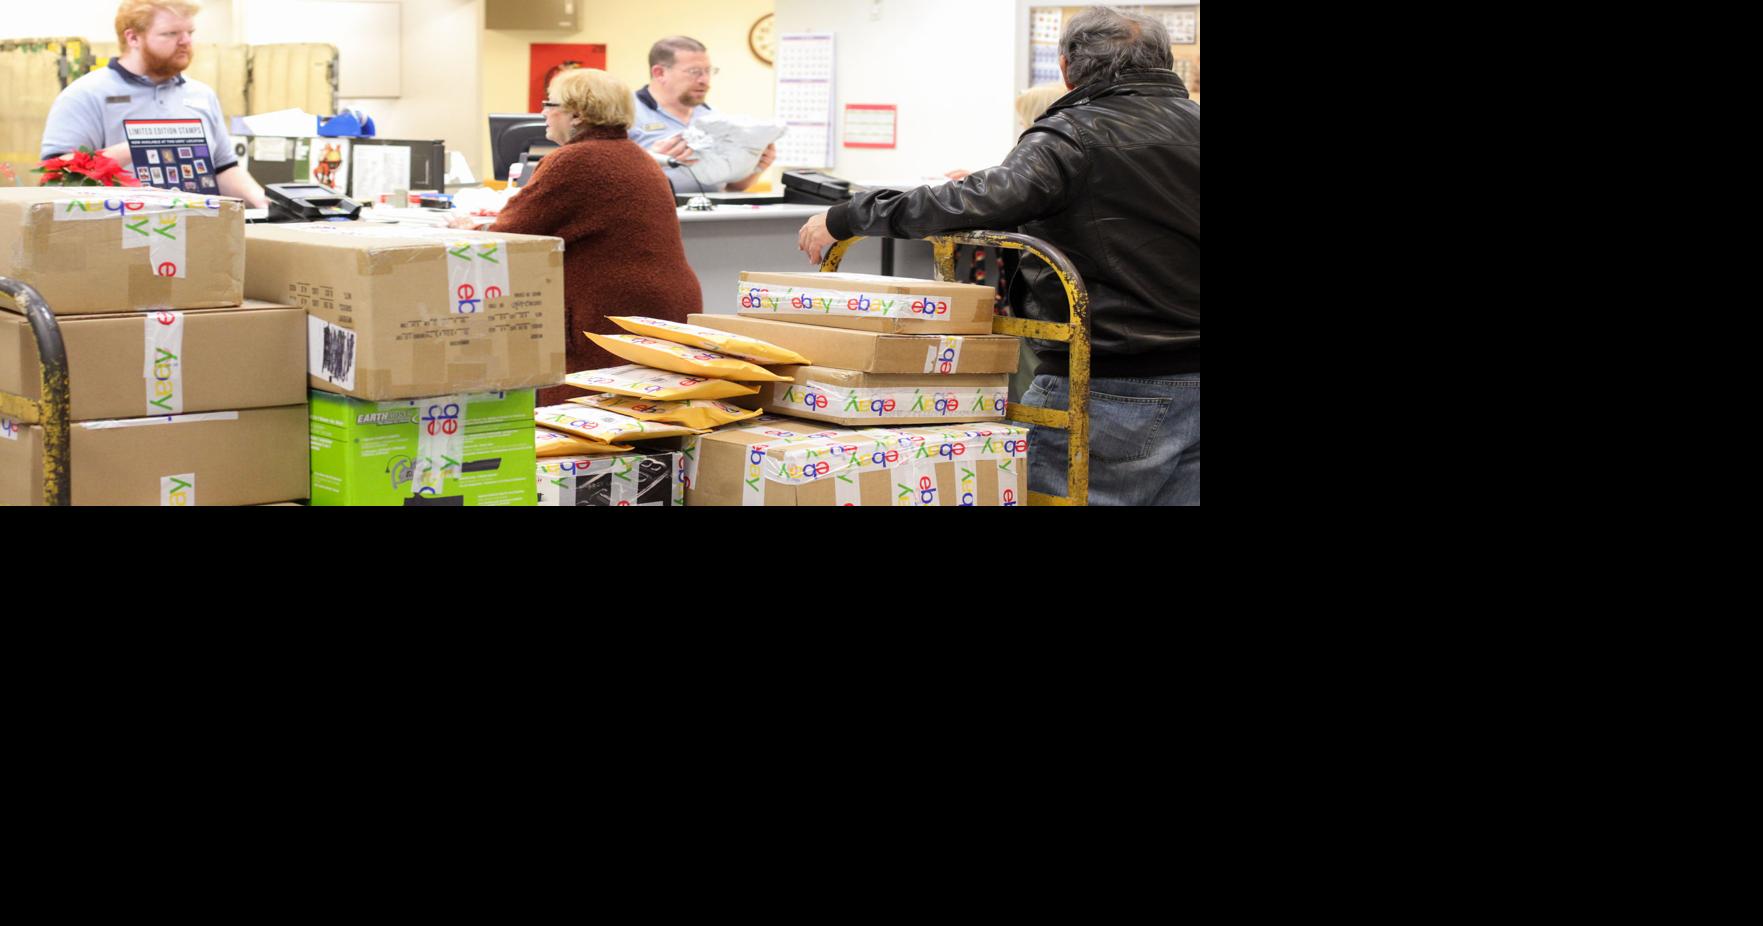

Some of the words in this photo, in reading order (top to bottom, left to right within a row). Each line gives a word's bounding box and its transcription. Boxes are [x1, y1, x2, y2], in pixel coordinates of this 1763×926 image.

[129, 127, 153, 135] LIMITED
[154, 127, 177, 135] EDITION
[741, 292, 779, 312] ebay
[791, 293, 833, 313] ebay
[847, 294, 894, 315] ebay
[783, 385, 829, 411] ebay
[844, 389, 896, 416] ebay
[911, 388, 959, 416] ebay
[916, 441, 966, 460] ebay
[982, 437, 1027, 457] ebay
[779, 461, 830, 480] ebay
